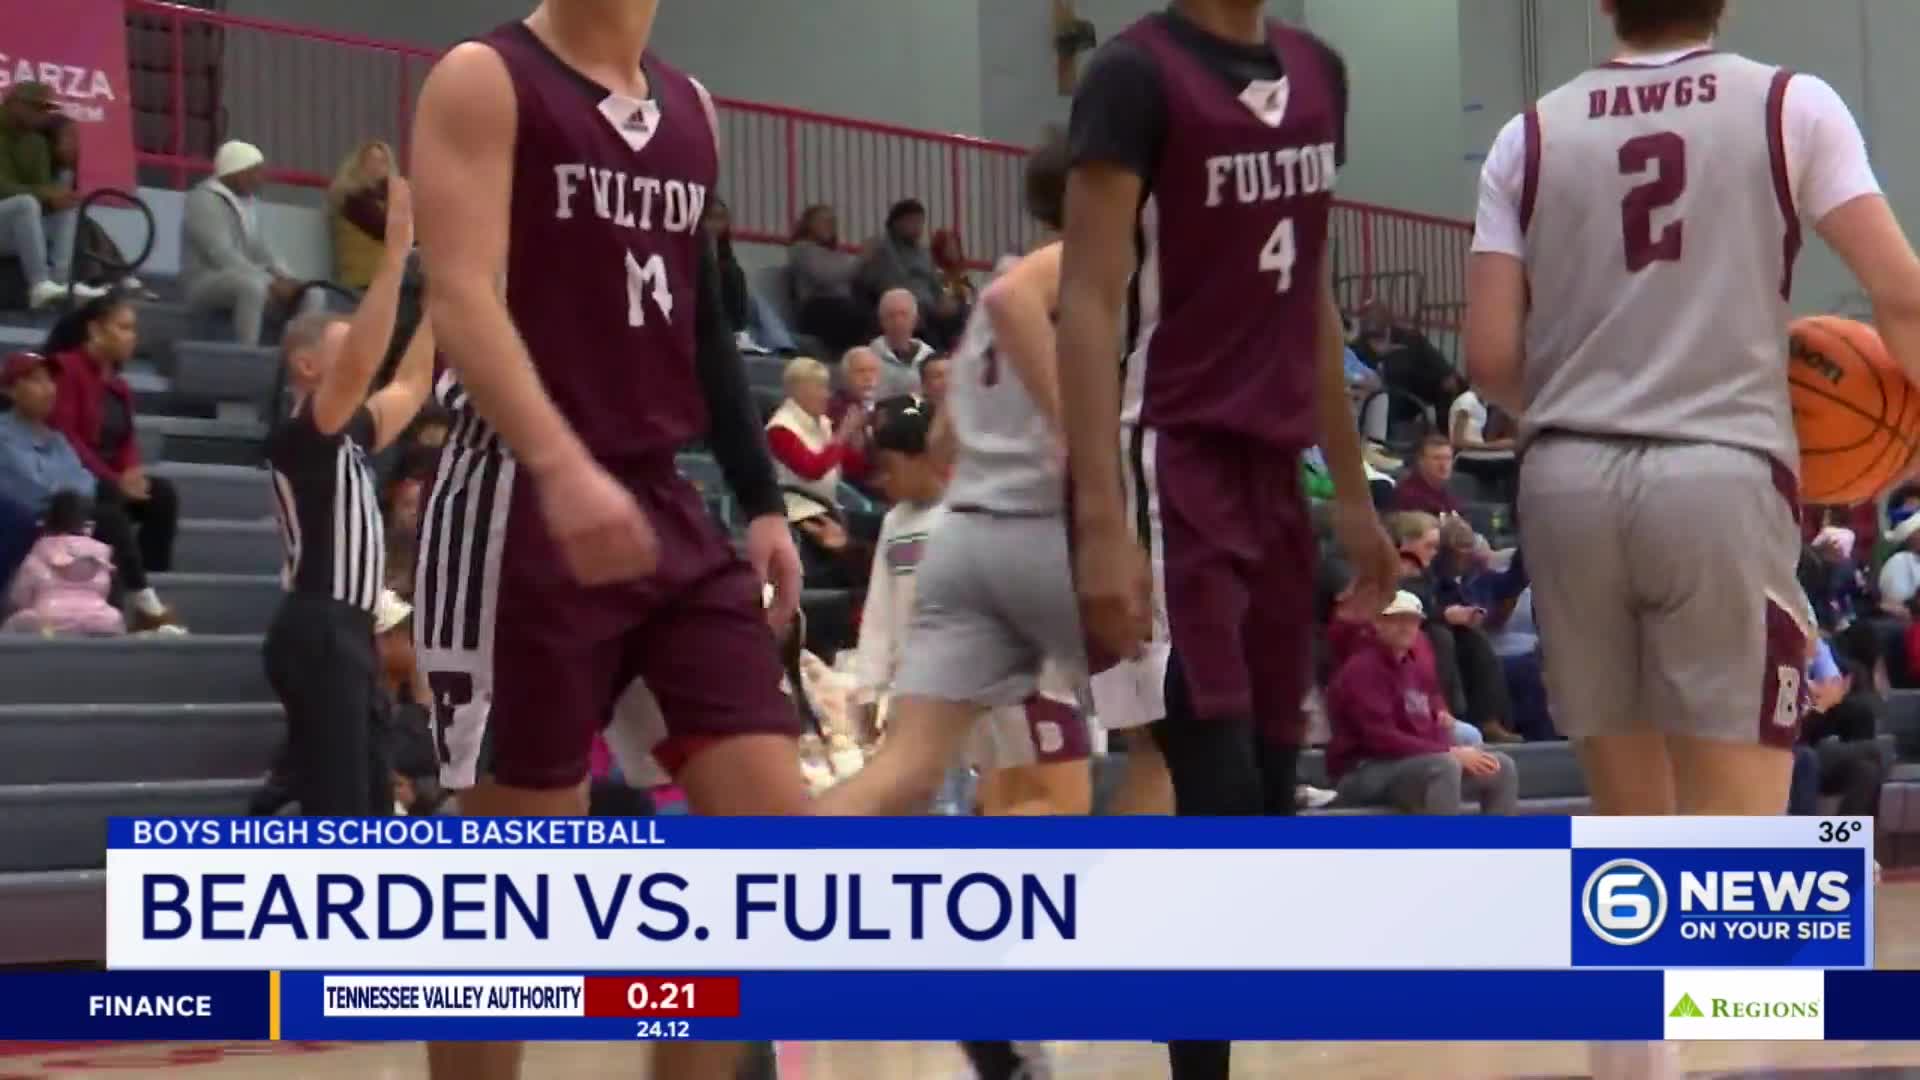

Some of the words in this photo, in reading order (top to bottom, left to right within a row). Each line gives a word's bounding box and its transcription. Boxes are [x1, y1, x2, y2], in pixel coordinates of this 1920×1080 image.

[1588, 74, 1717, 119] DAWGS
[554, 164, 705, 235] FULTON
[1205, 143, 1336, 207] FULTON
[1618, 132, 1686, 273] 2
[1258, 217, 1296, 293] 4
[1773, 664, 1800, 728] B
